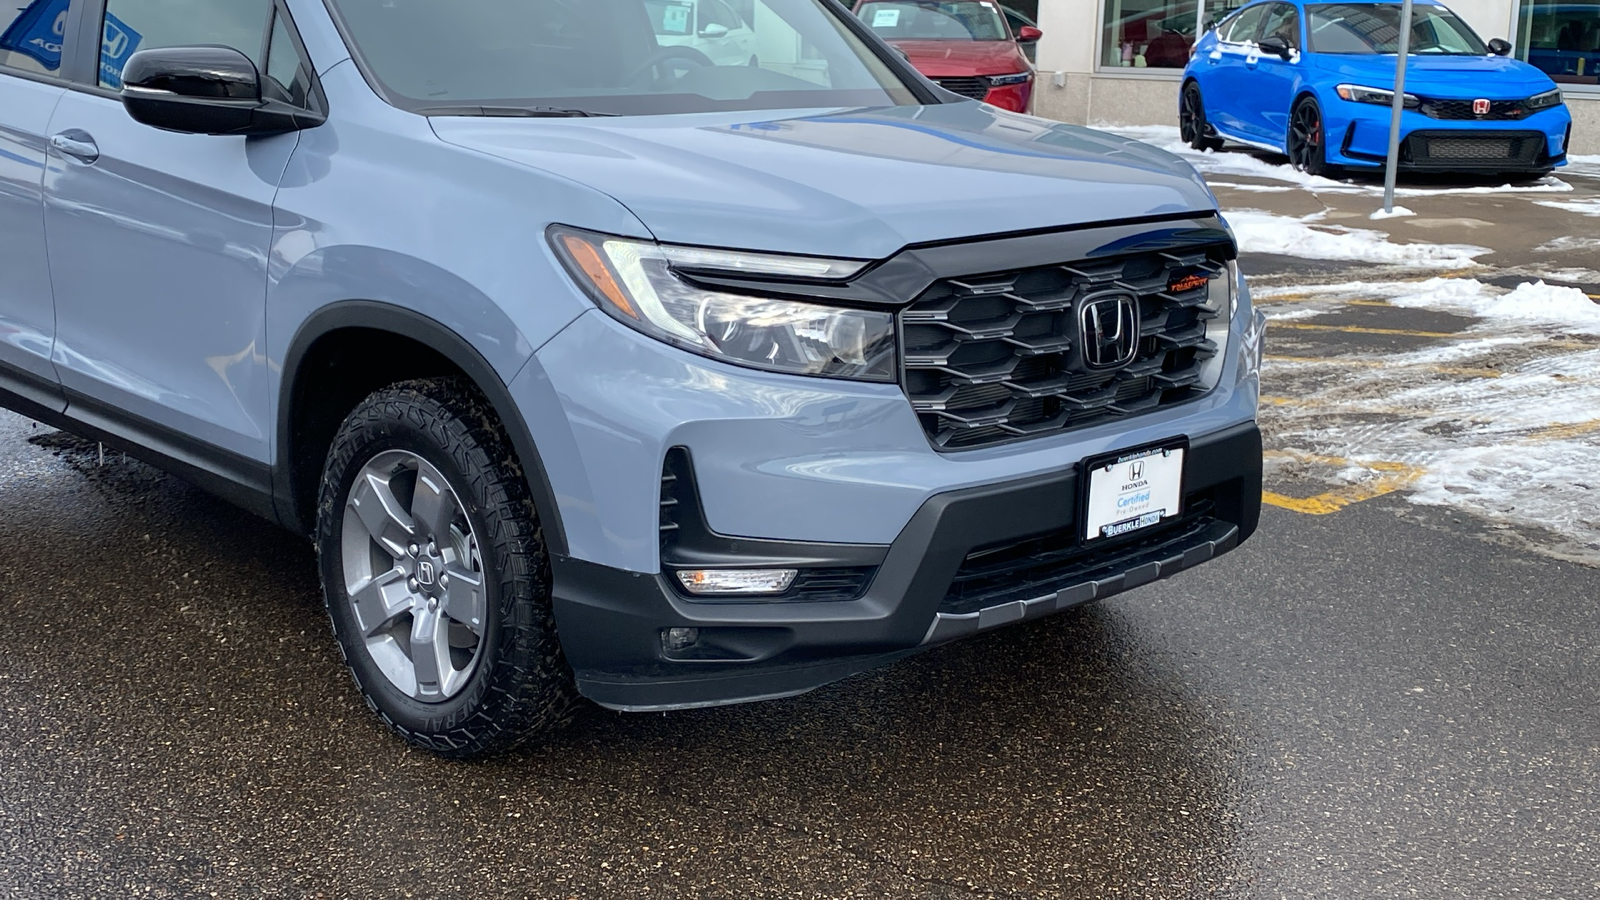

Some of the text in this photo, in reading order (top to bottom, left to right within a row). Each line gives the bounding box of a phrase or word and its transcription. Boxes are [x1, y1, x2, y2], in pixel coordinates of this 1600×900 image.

[1121, 480, 1148, 491] HONDA
[1117, 491, 1150, 508] Certified
[1116, 503, 1149, 516] Pre-Owned
[1107, 515, 1159, 536] BUERKLE HONDA
